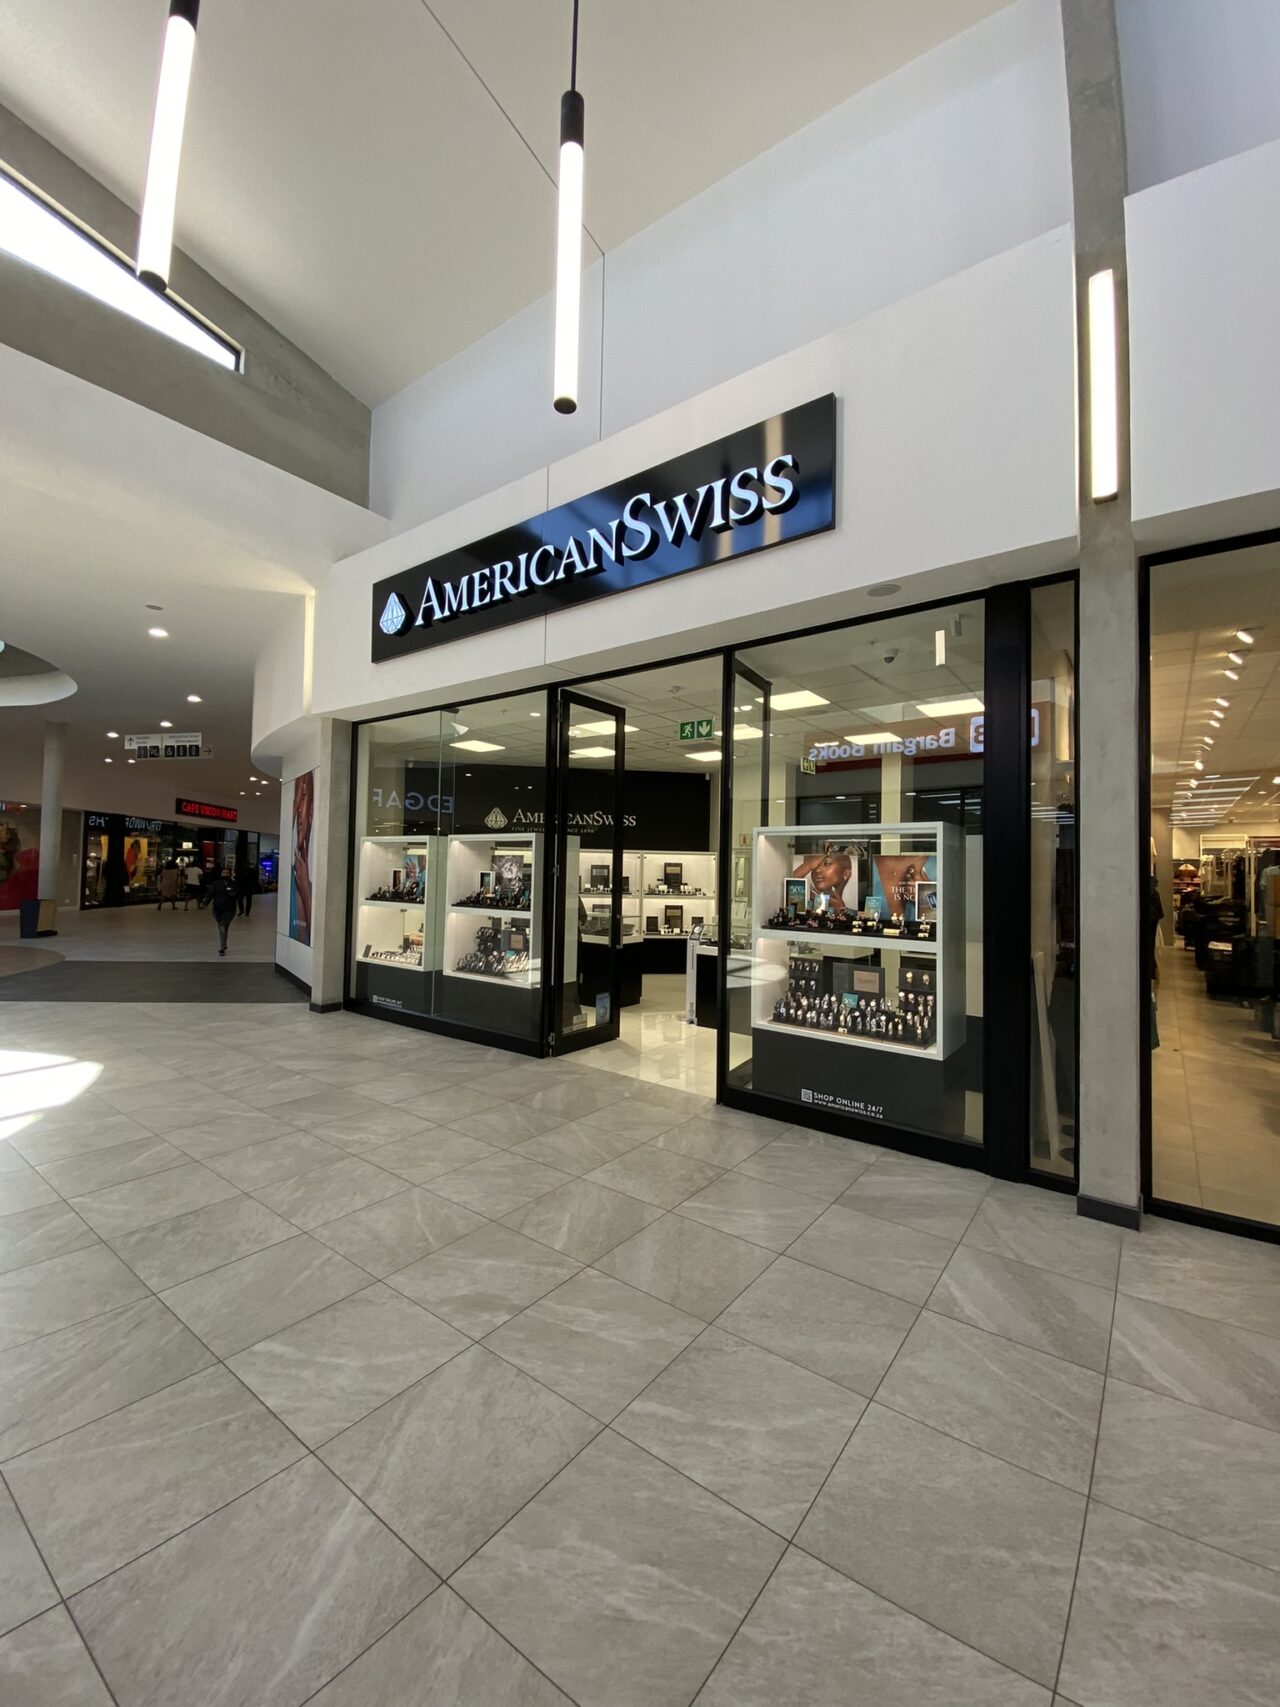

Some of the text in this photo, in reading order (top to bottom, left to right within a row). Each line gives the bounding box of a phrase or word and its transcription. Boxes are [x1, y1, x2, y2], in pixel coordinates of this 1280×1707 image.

[813, 1091, 883, 1113] SHOP ONLINE 24/7
